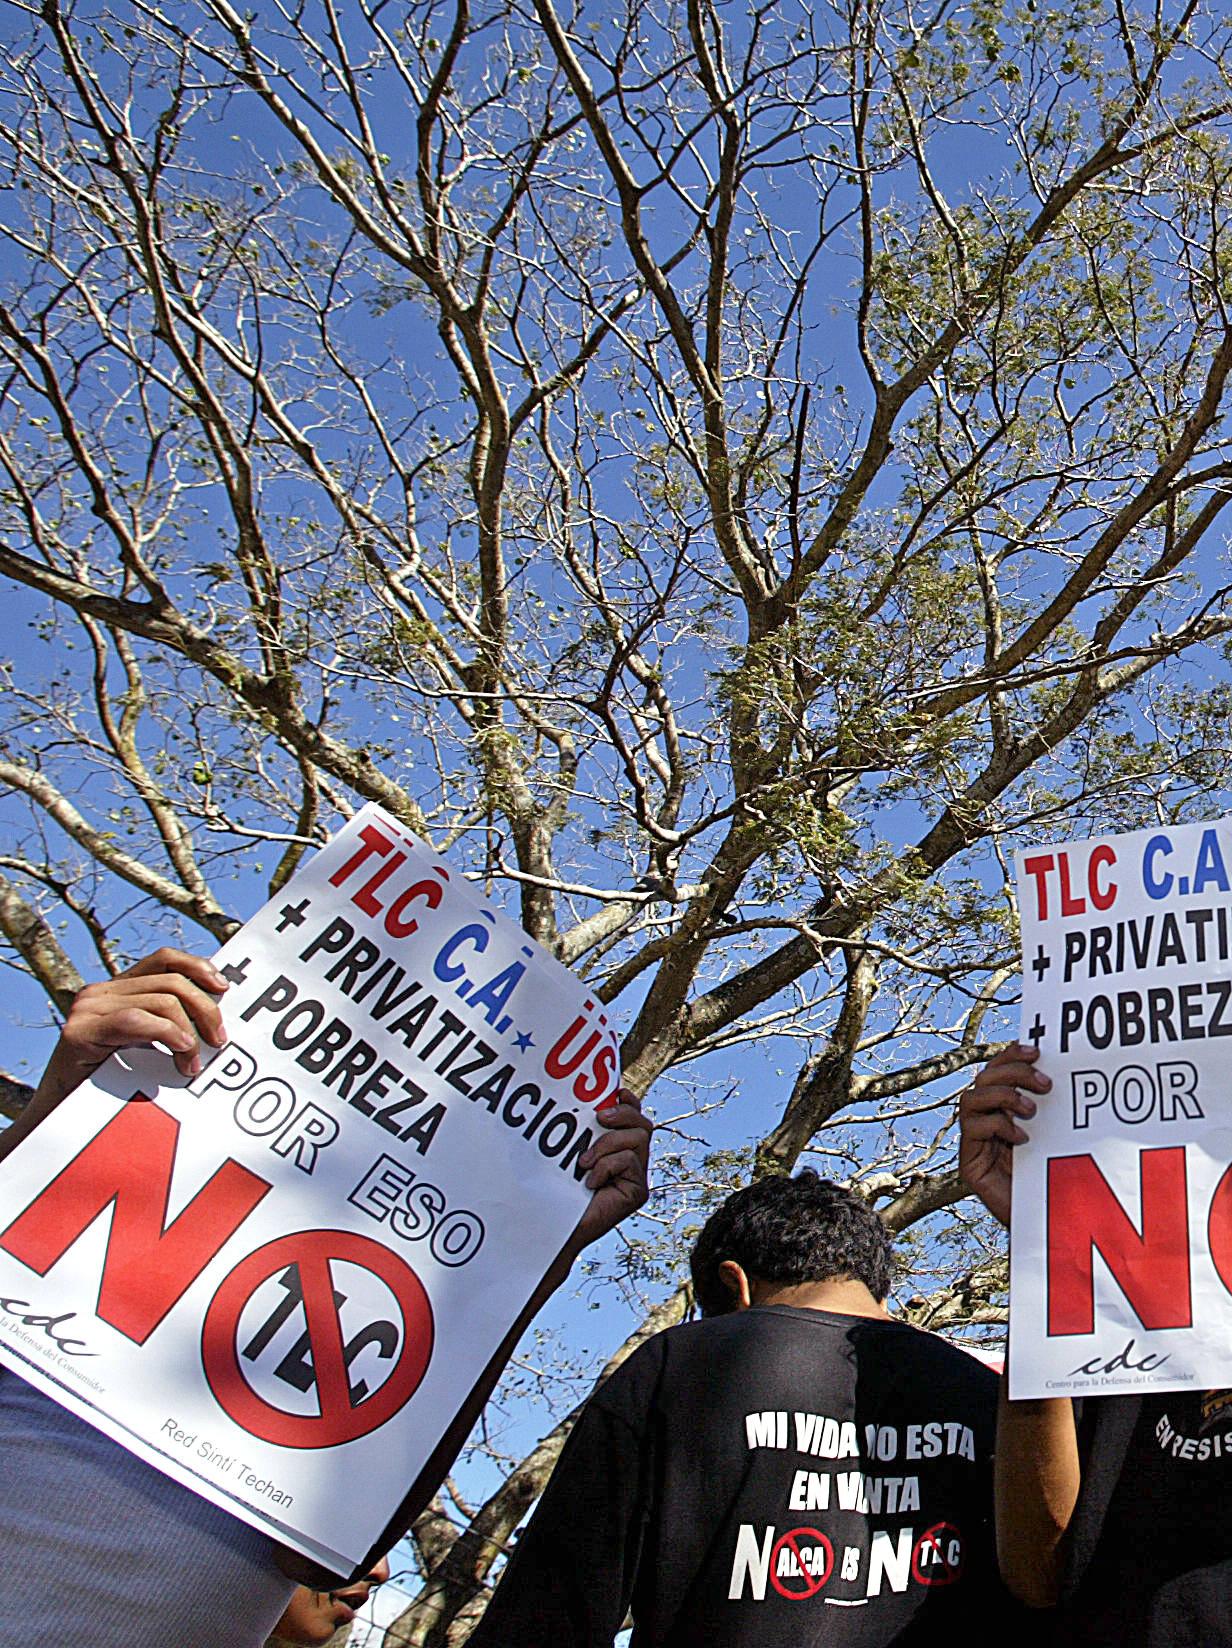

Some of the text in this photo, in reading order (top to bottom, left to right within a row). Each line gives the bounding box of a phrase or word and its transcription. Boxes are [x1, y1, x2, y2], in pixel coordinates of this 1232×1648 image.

[1024, 844, 1118, 921] TLC
[328, 825, 443, 939] TLC
[433, 923, 514, 1035] C.A.
[240, 974, 448, 1157] POBREZA
[299, 916, 594, 1183] PRIVATIZACIÓN
[1071, 1060, 1205, 1130] POR
[190, 1041, 486, 1268] POR ESO
[1067, 1338, 1173, 1377] cdc
[160, 1417, 198, 1449] Red
[236, 1463, 295, 1509] Techan
[745, 1411, 789, 1450] MI
[794, 1412, 860, 1460] VIDA
[906, 1422, 976, 1462] ESTA
[788, 1470, 830, 1511] EN
